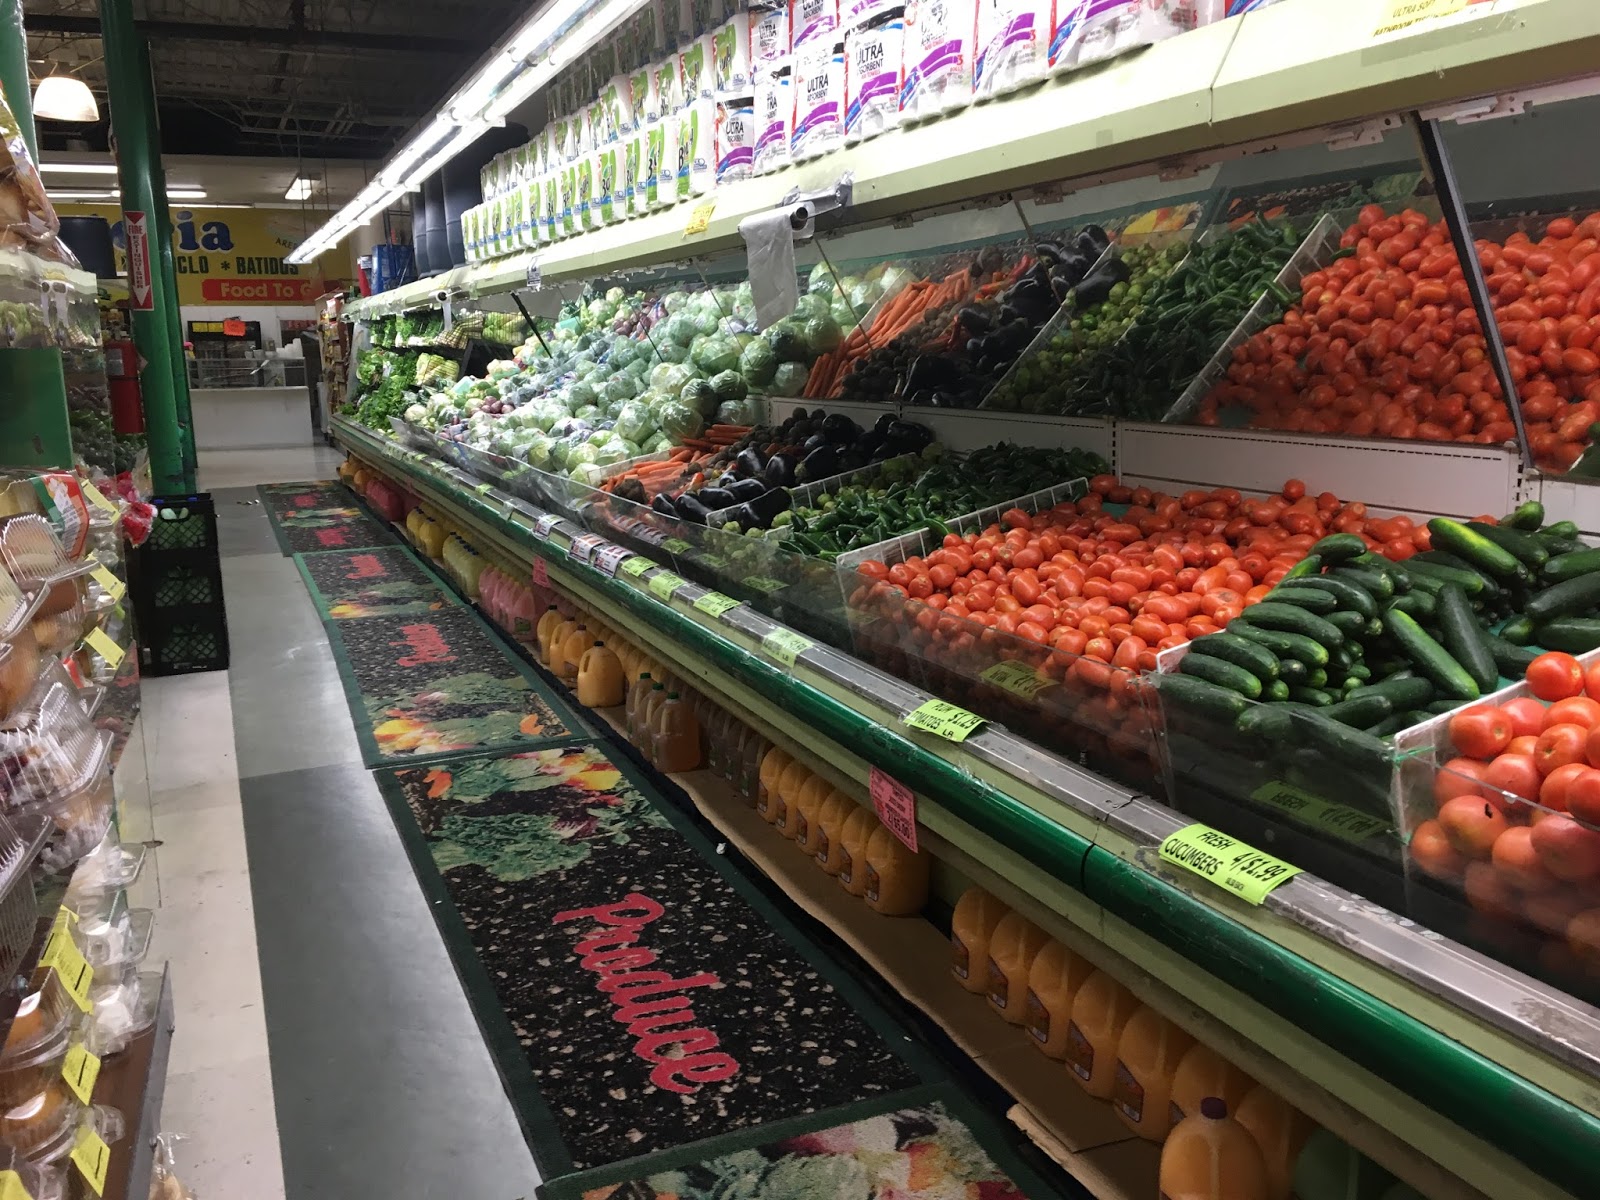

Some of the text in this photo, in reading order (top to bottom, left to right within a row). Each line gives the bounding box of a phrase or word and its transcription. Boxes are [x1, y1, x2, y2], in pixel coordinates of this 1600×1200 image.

[1392, 4, 1417, 18] ULTRA
[859, 58, 884, 74] SORBENT
[807, 73, 829, 93] ULTRA
[725, 121, 744, 135] ULTRA
[128, 225, 143, 234] FIRE
[176, 211, 234, 251] ia
[133, 235, 144, 288] EXTINGUISHER
[175, 256, 299, 275] CLO BATIDOS
[220, 282, 267, 297] Food
[273, 282, 295, 297] To
[1196, 832, 1235, 851] FRESH
[1165, 838, 1288, 882] CUCUMBERS 4/$1.99
[552, 893, 740, 1094] Produce
